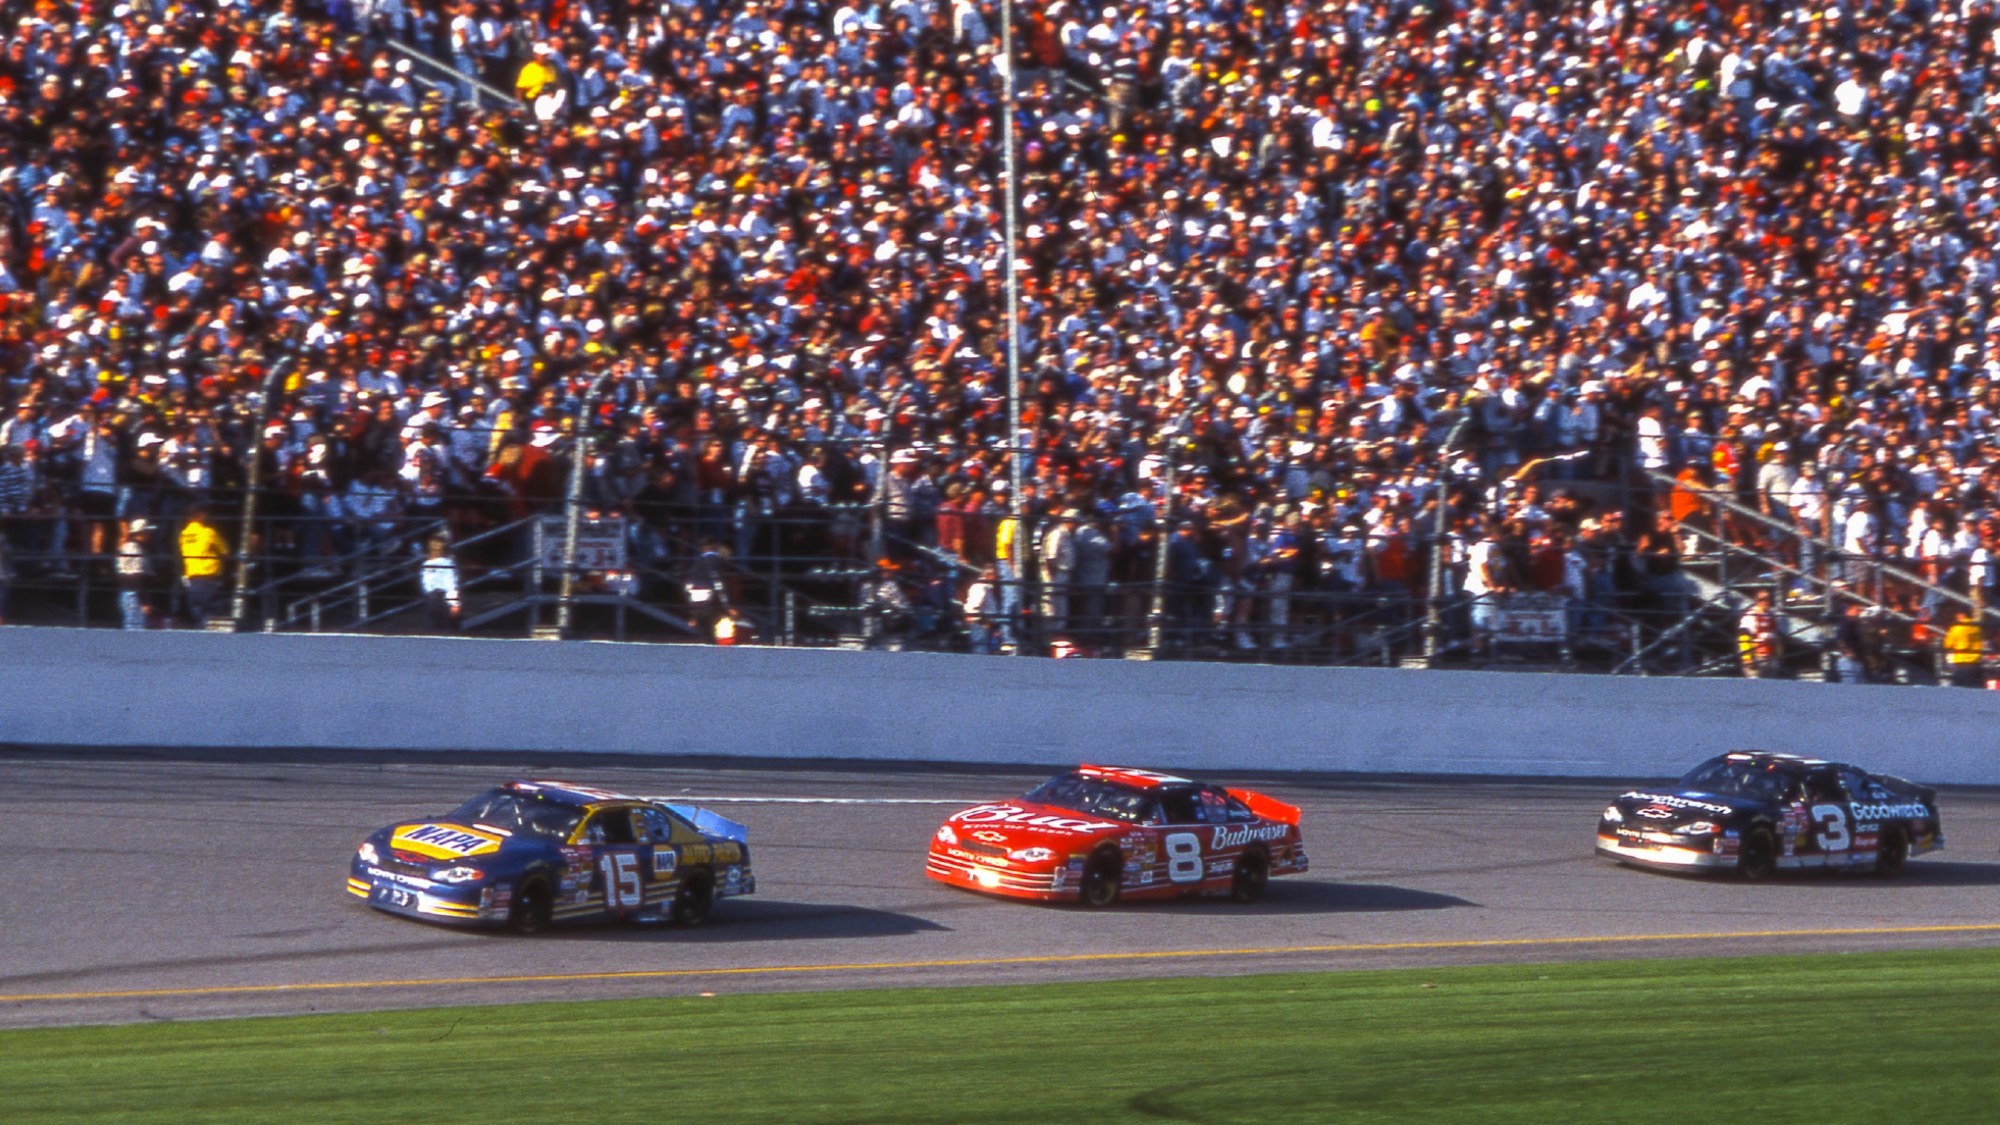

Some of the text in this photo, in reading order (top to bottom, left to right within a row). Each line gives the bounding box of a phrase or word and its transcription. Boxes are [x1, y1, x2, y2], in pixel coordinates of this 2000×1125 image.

[403, 824, 489, 852] NAPA
[1211, 824, 1289, 850] Budweiser
[1811, 804, 1850, 850] 3
[600, 853, 641, 908] 15
[1165, 832, 1204, 883] 8
